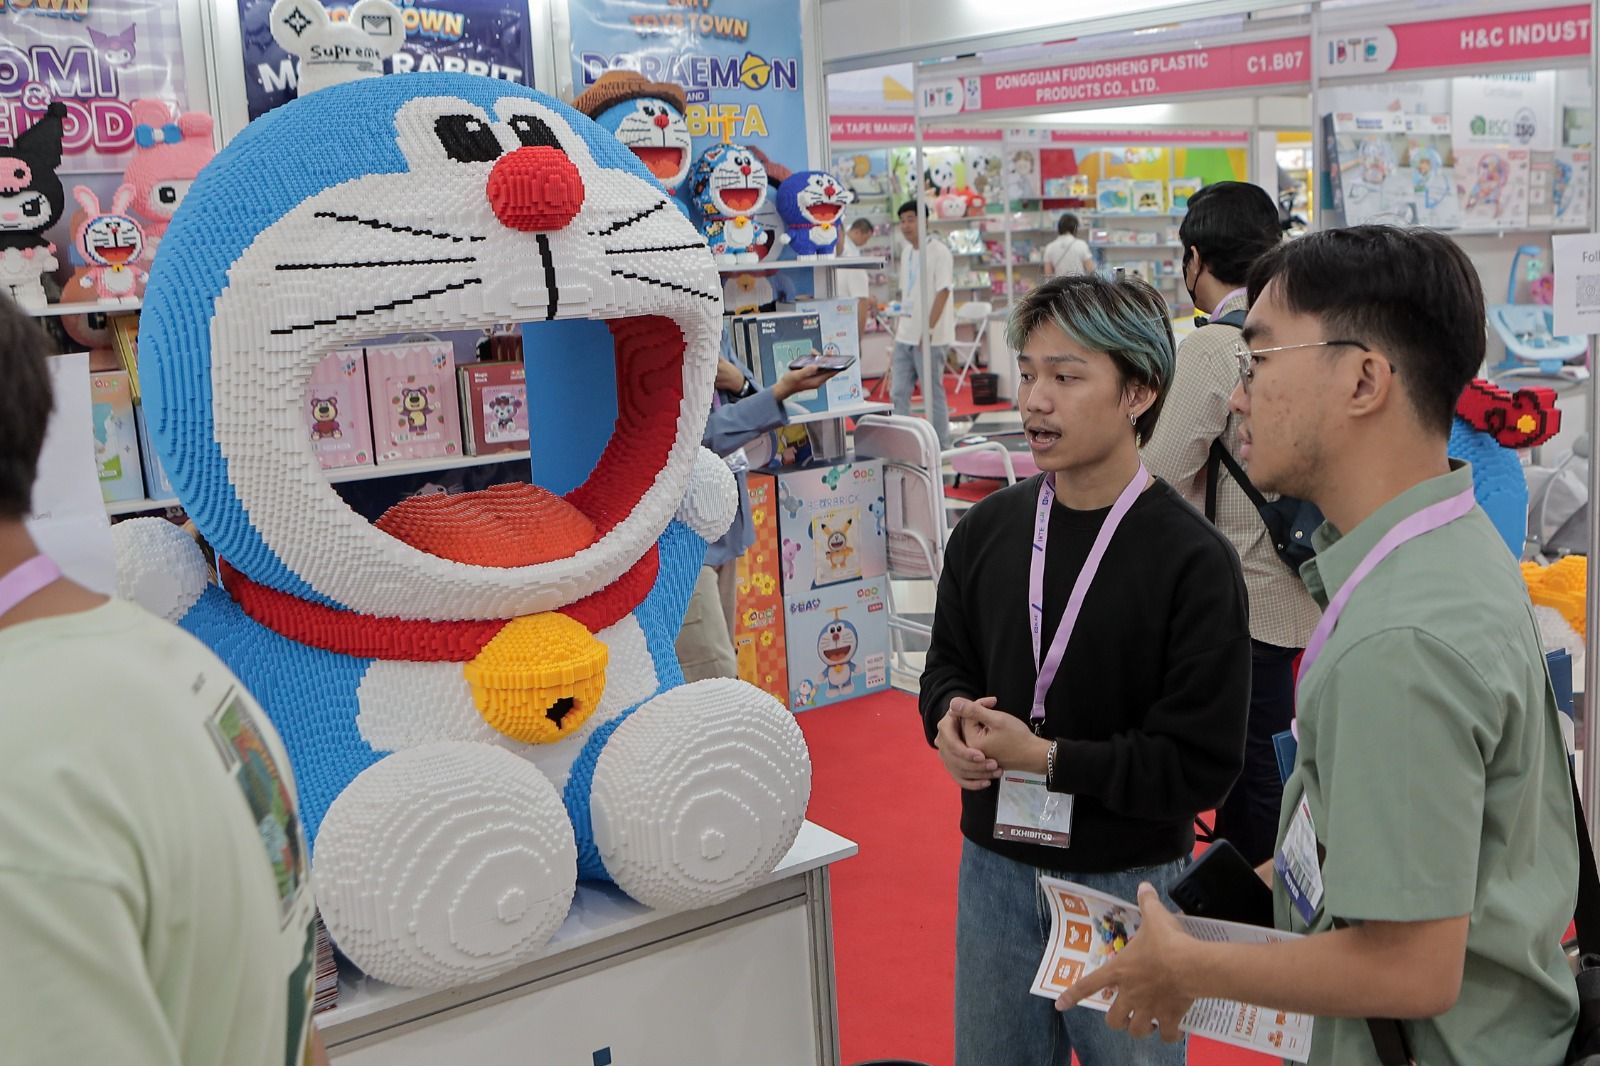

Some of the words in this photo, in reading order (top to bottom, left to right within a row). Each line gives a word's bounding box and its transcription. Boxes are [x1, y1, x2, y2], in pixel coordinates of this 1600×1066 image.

[402, 8, 463, 36] OWN
[688, 13, 748, 37] TOWN
[1460, 28, 1504, 50] H&C
[310, 45, 381, 60] Supreme
[1247, 51, 1304, 73] C1.B07
[995, 71, 1060, 90] DONGGUAN
[1062, 60, 1149, 82] FUDUOSHENG
[1151, 52, 1209, 73] PLASTIC
[22, 82, 52, 112] &
[686, 90, 705, 101] AND
[1036, 79, 1101, 102] PRODUCTS
[1103, 79, 1130, 98] CO.,
[1131, 76, 1160, 94] LTD.
[684, 104, 769, 137] BITA
[846, 122, 871, 134] TAPE
[1010, 828, 1053, 841] EXHIBITOR
